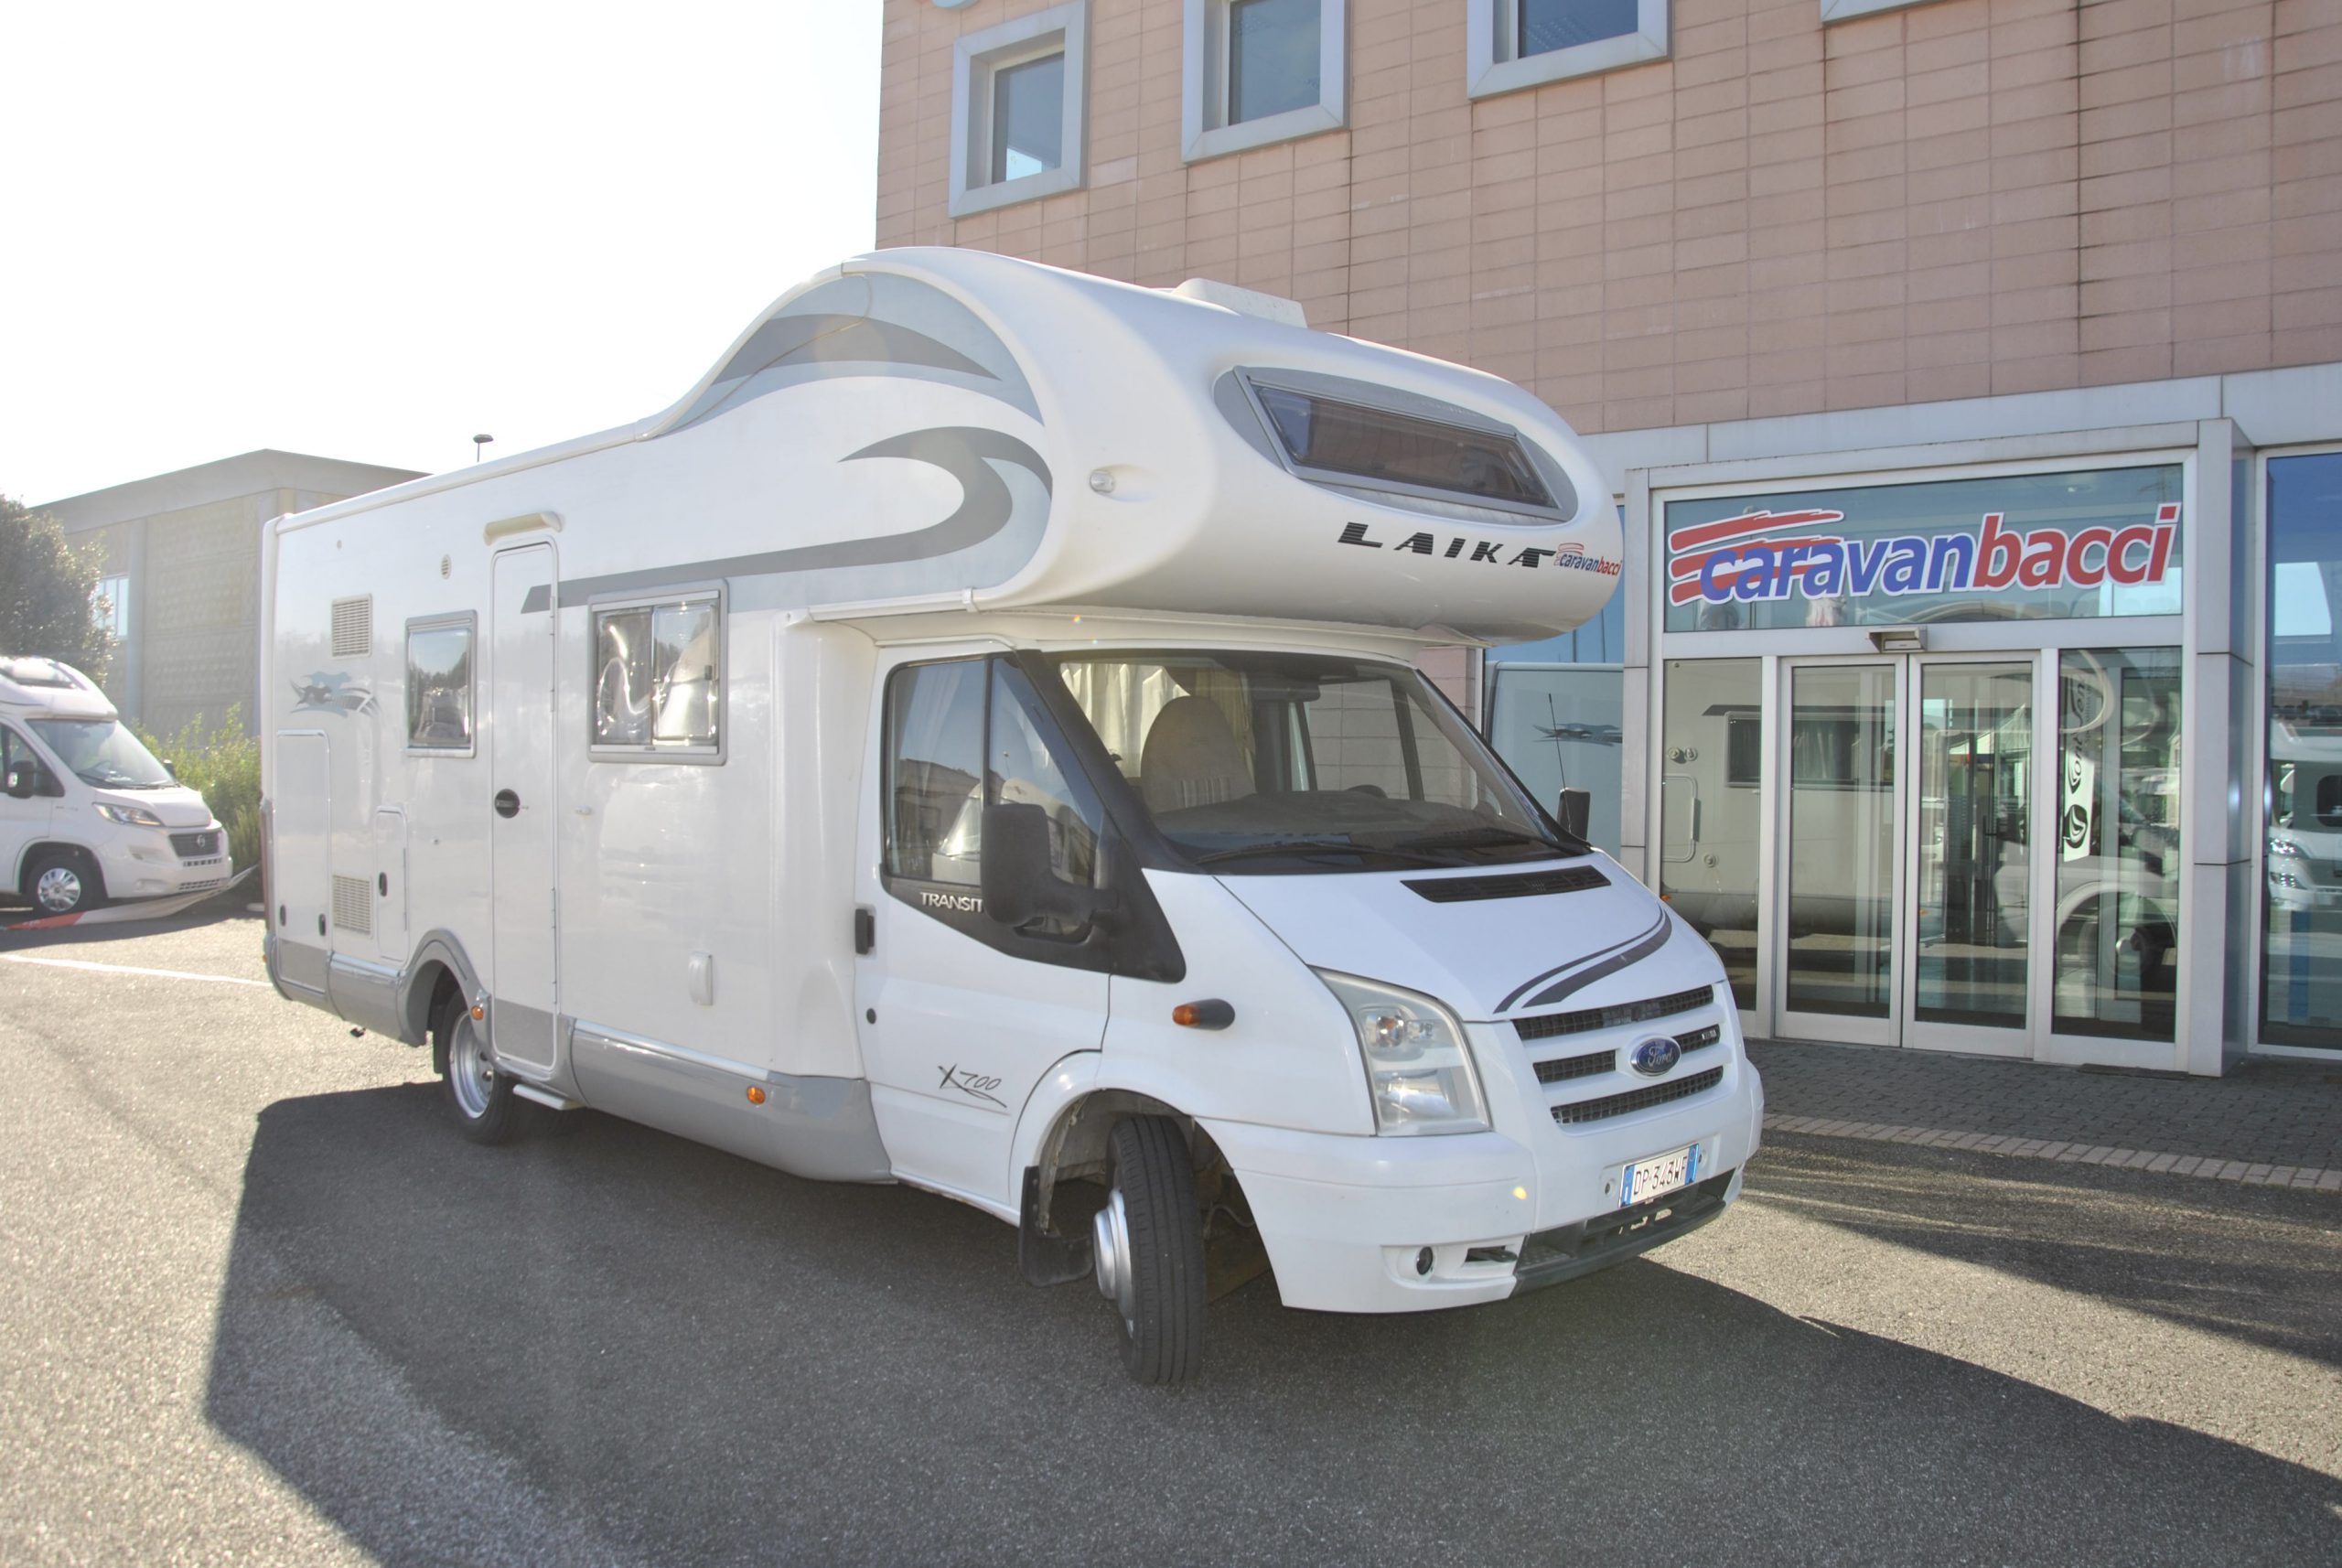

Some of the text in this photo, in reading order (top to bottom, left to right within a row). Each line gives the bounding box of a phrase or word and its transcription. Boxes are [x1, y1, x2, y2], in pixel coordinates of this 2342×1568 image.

[1338, 521, 1556, 568] LAIKA
[1699, 503, 2180, 604] caravanbacci
[1559, 553, 1623, 577] caravanbacci
[920, 892, 983, 912] TRANSIT
[1648, 1046, 1675, 1068] Ford
